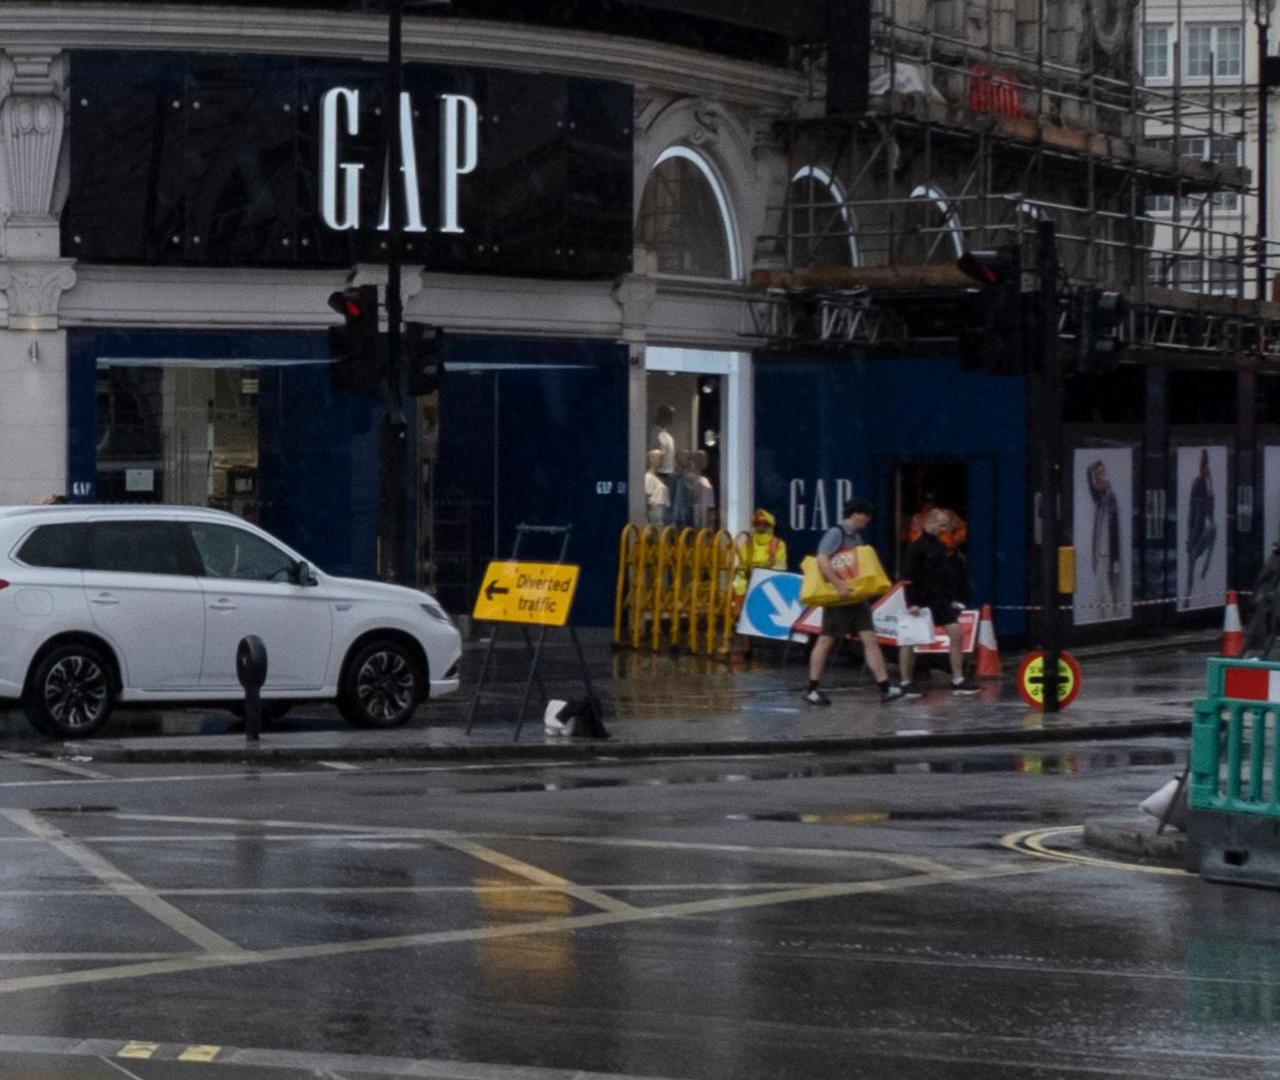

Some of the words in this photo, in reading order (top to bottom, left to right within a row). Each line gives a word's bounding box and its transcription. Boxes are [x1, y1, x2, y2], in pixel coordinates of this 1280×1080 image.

[320, 86, 479, 234] GAP
[516, 573, 572, 592] Diverted
[518, 596, 558, 613] traffic
